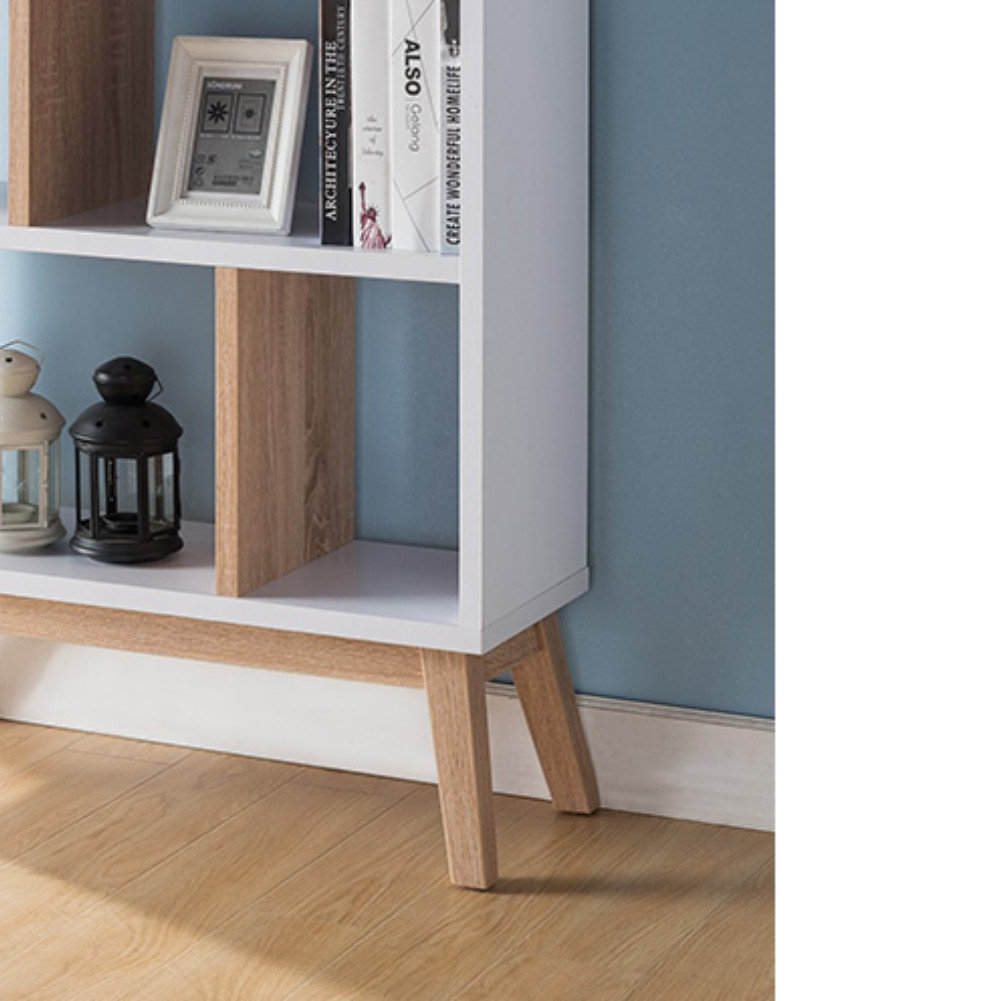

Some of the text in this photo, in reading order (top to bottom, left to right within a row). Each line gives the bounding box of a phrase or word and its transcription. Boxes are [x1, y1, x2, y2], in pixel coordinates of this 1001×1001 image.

[324, 41, 338, 221] ARCHITECYURE IN THE
[404, 39, 421, 96] ALSO
[445, 65, 461, 245] CREATE WONDERFUL HOMELIFE
